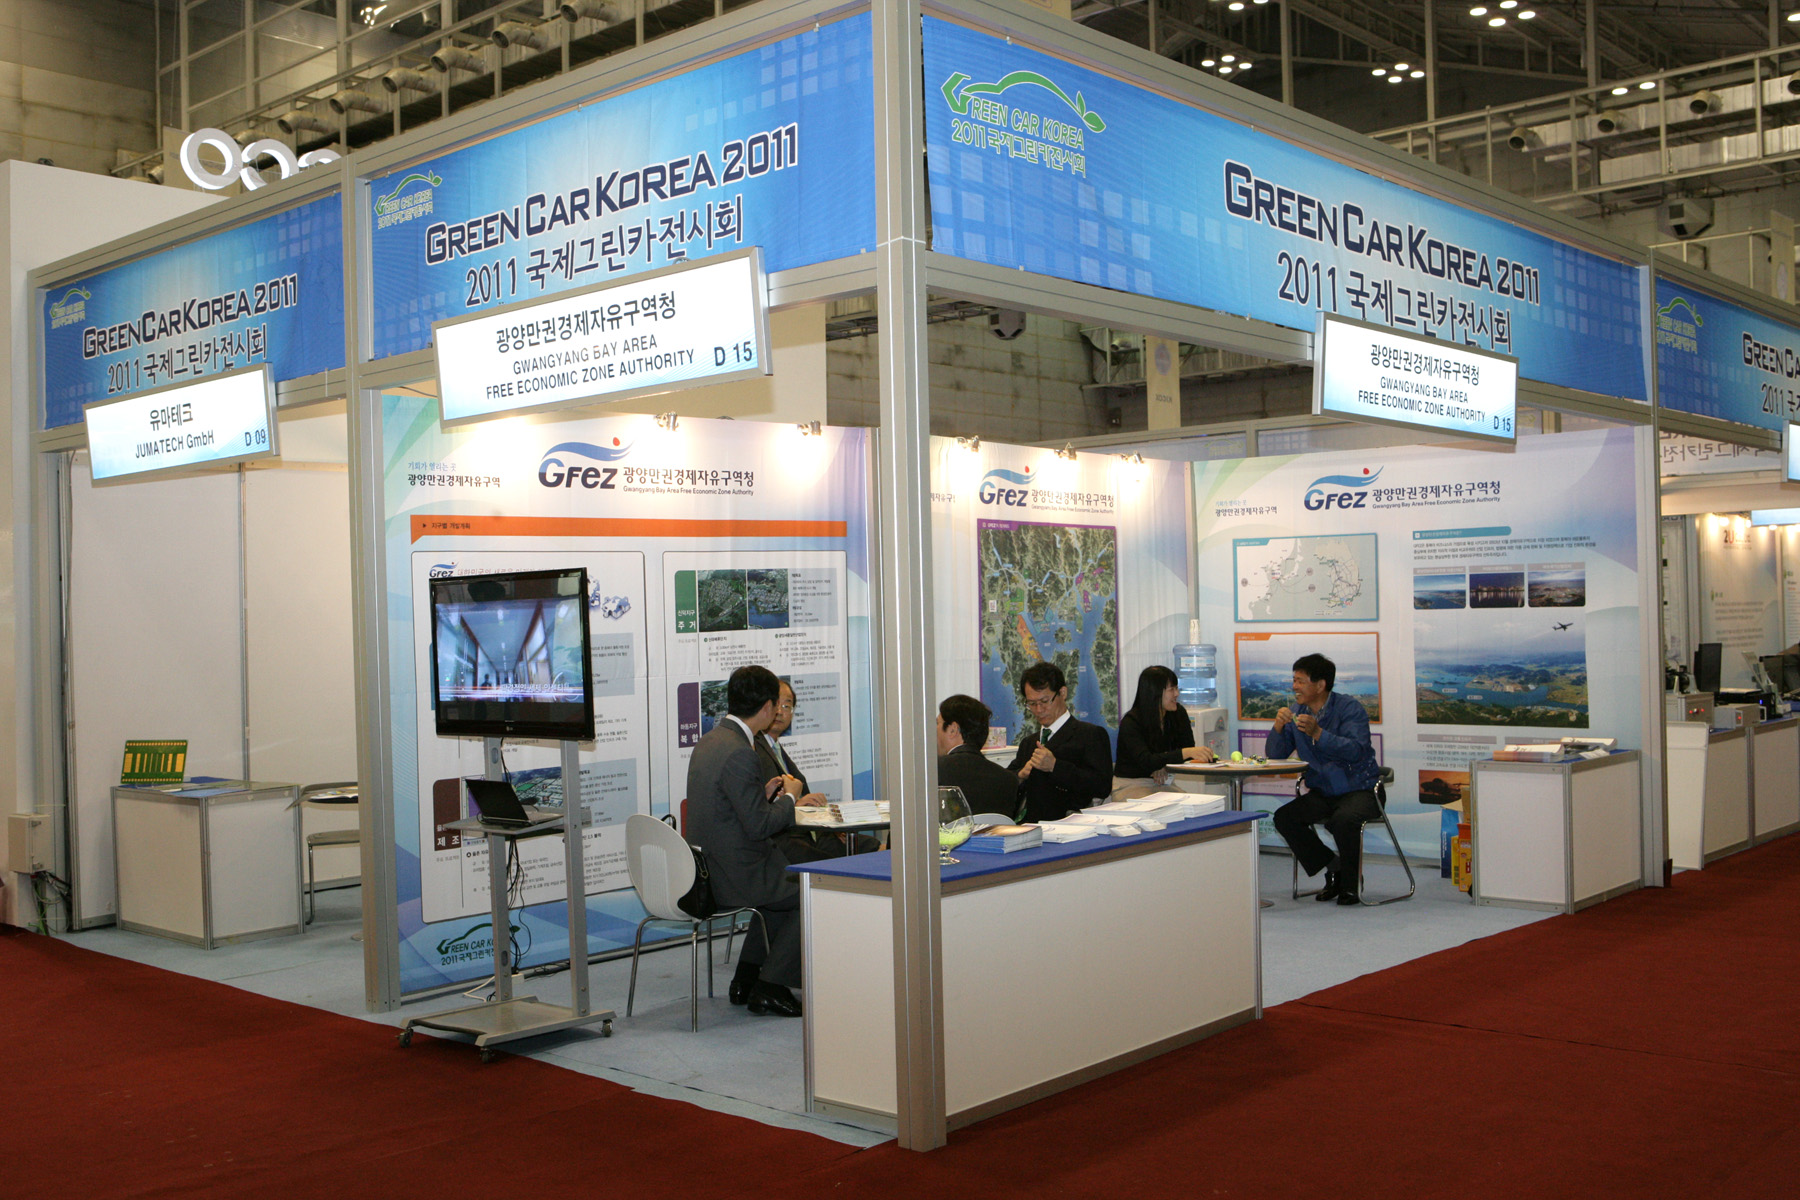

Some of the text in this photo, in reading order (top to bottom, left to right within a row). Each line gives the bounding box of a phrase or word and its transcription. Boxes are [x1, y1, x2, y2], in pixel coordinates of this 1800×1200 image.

[1012, 107, 1040, 136] CAR
[1042, 118, 1084, 150] KOREA
[722, 122, 799, 188] 2011
[465, 195, 744, 308] 2011 국제그린카전시회
[254, 273, 298, 316] 2011
[1496, 256, 1540, 306] 2011
[1278, 251, 1512, 354] 2011 국제그린카전시회
[496, 290, 677, 353] 광양만권경제자유구역청
[108, 324, 267, 393] 2011 국제그린카전시회
[512, 336, 658, 375] GWANGYANG BAY AREA
[714, 341, 753, 367] D 15
[1370, 344, 1480, 386] 광양만권경제자유구역청
[486, 348, 694, 401] FREE ECONOMIC ZONE AUTHORITY
[1380, 376, 1468, 404] GWANGYANG BAY AREA
[1358, 390, 1486, 422] FREE ECONOMIC ZONE AUTHORITY
[1762, 382, 1784, 416] 2011
[149, 403, 193, 431] 유마테크
[1493, 416, 1511, 432] D 15
[135, 430, 214, 459] JUMATECH GmbH
[244, 429, 266, 448] D 09
[408, 474, 500, 488] 광양만권경제자유구역
[623, 466, 754, 488] 광양만권경제자유구역청
[623, 486, 655, 494] Gwangyang
[656, 486, 666, 494] Bay
[1372, 482, 1500, 502] 광양만권경제자유구역청
[1216, 506, 1278, 516] 광양만권경제자유구역
[470, 940, 485, 950] CAR
